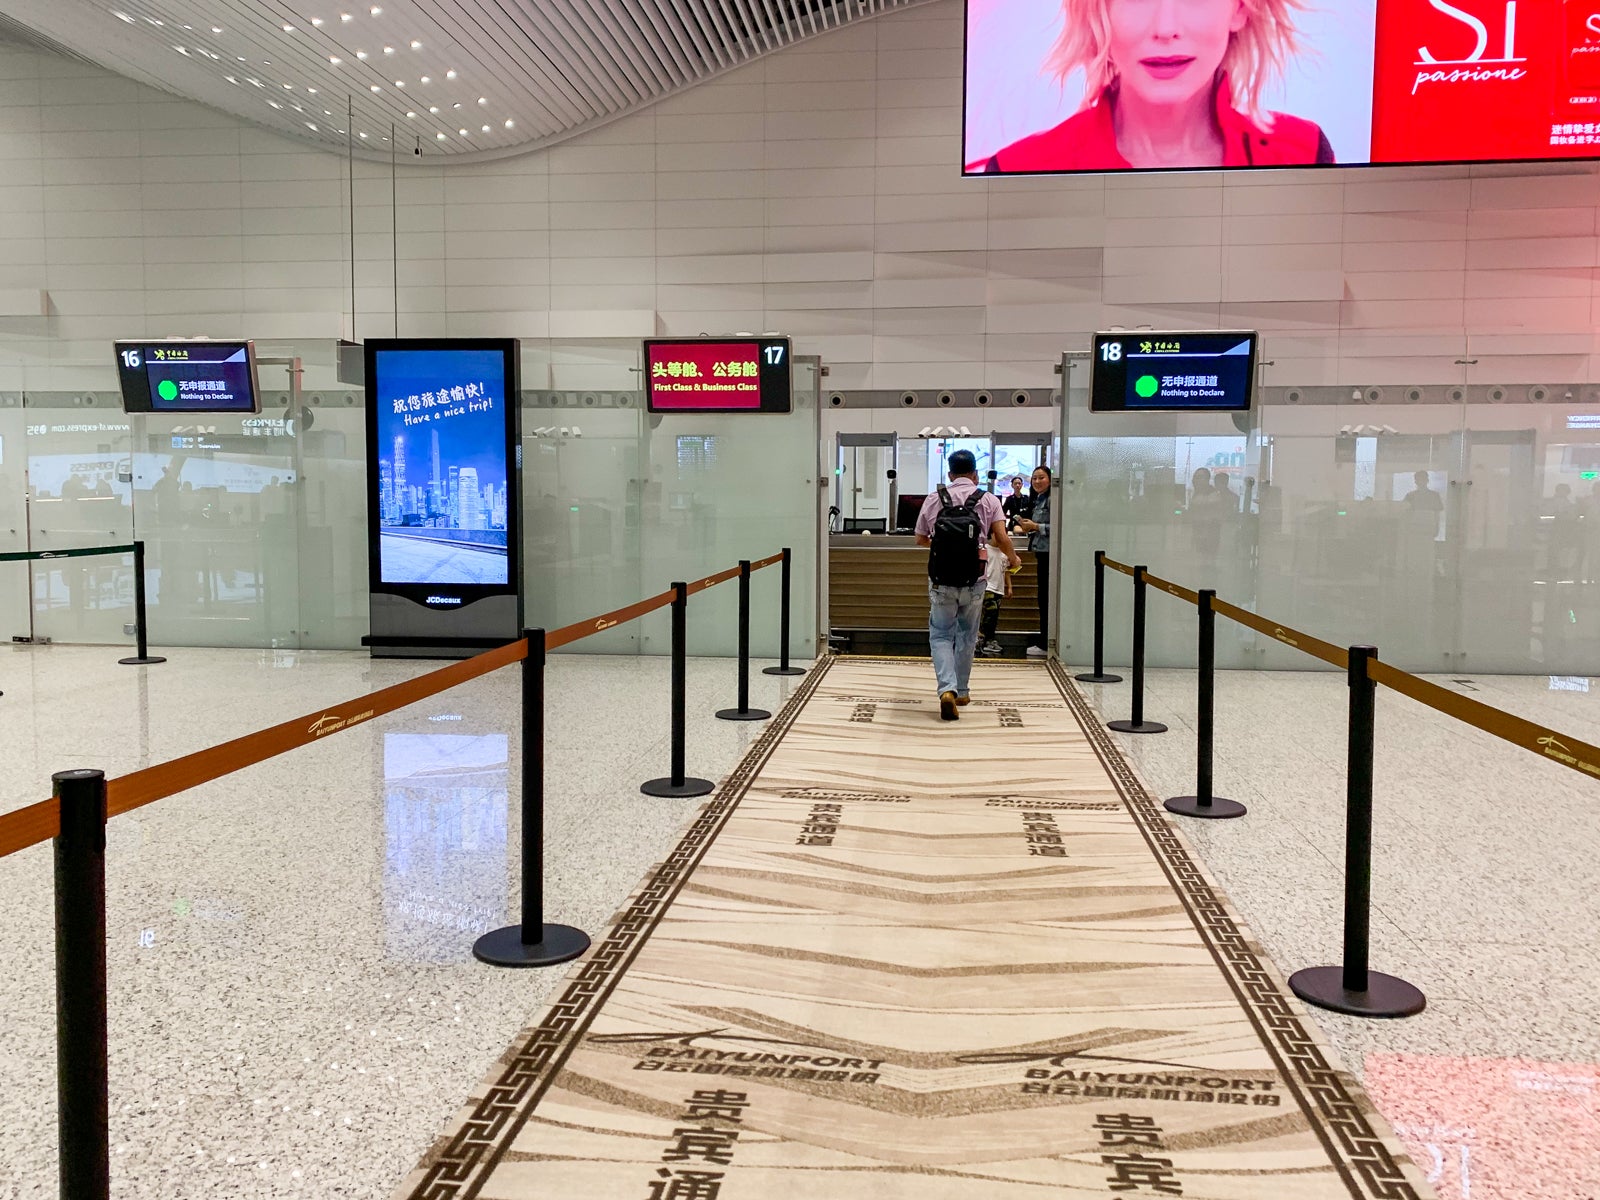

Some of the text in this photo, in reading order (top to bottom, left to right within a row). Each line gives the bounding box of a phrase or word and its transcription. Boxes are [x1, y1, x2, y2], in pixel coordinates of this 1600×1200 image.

[1411, 67, 1527, 95] passione
[121, 350, 140, 368] 16
[764, 346, 784, 364] 17
[1100, 342, 1122, 361] 18
[179, 380, 226, 391] 无申报通道
[654, 382, 758, 391] First Class & Business Class
[1161, 375, 1218, 387] 无申报通道
[180, 393, 204, 401] Nothing
[1161, 389, 1189, 398] Nothing
[1199, 389, 1225, 397] Declare
[403, 397, 493, 426] Have a nice trip!
[426, 596, 461, 604] JCDecaux
[644, 1047, 886, 1070] BAIYUNPORT
[1024, 1069, 1276, 1092] BAIYUNPORT
